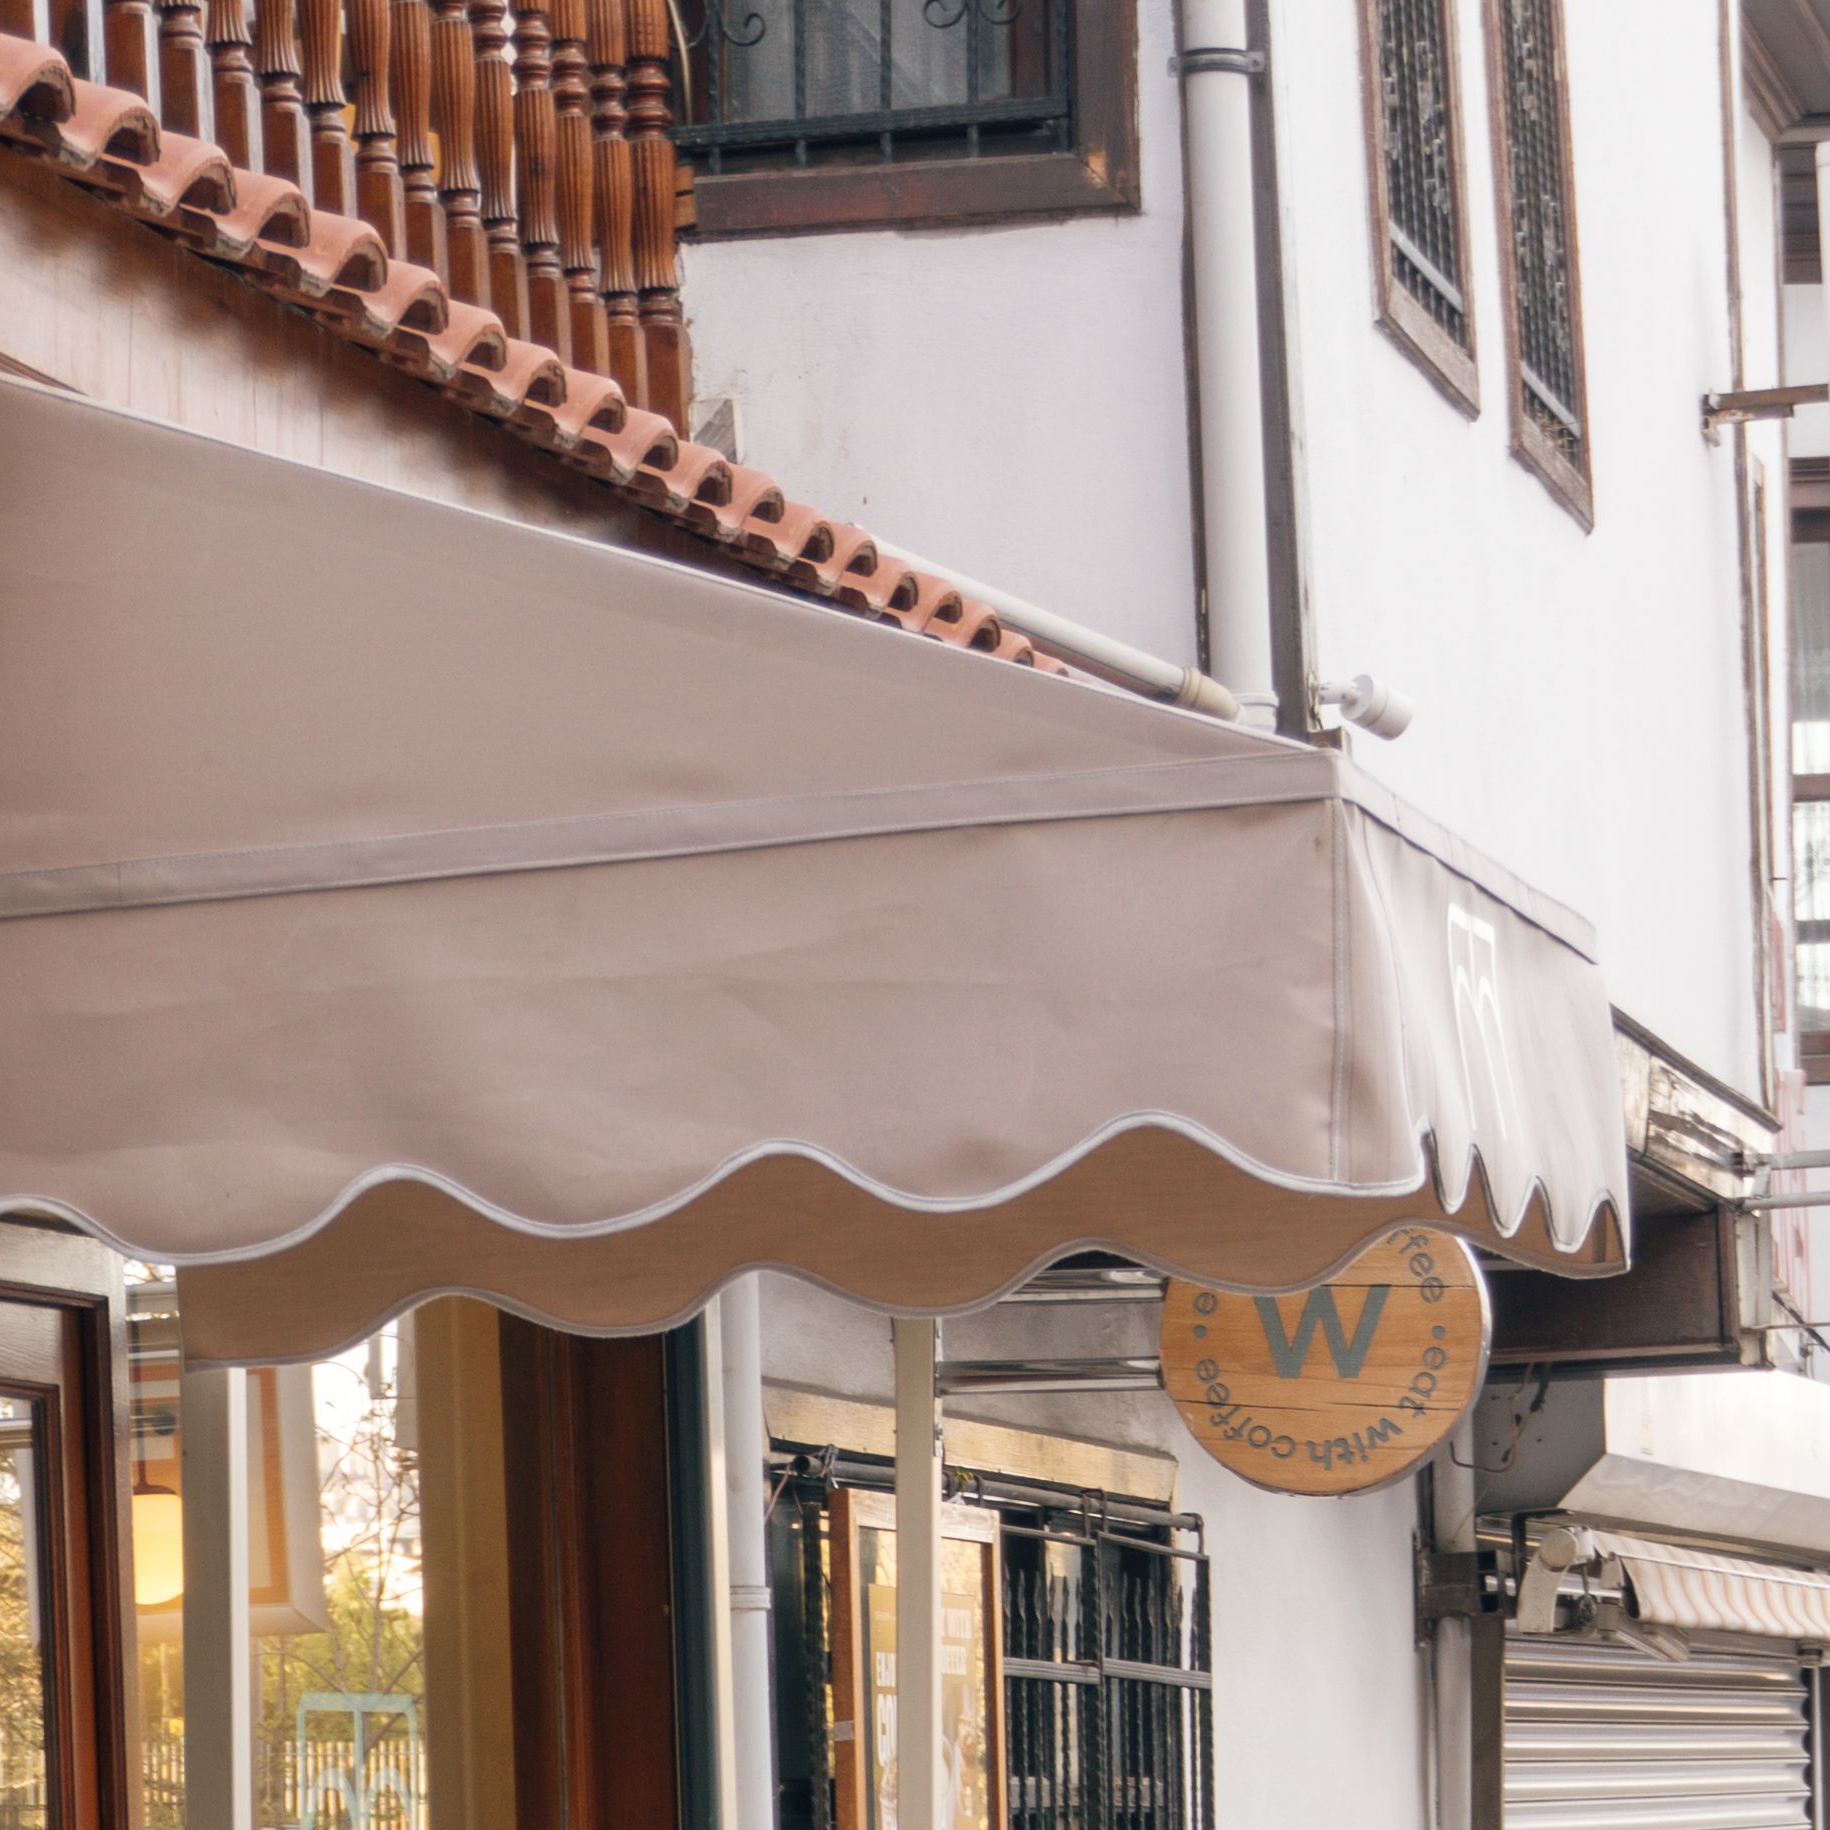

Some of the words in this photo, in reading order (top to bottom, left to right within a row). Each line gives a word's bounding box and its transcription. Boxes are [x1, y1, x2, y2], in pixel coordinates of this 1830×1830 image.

[1253, 1285, 1392, 1379] W
[1194, 1358, 1297, 1460] coffee
[1398, 1346, 1447, 1418] eat
[1306, 1418, 1403, 1471] with
